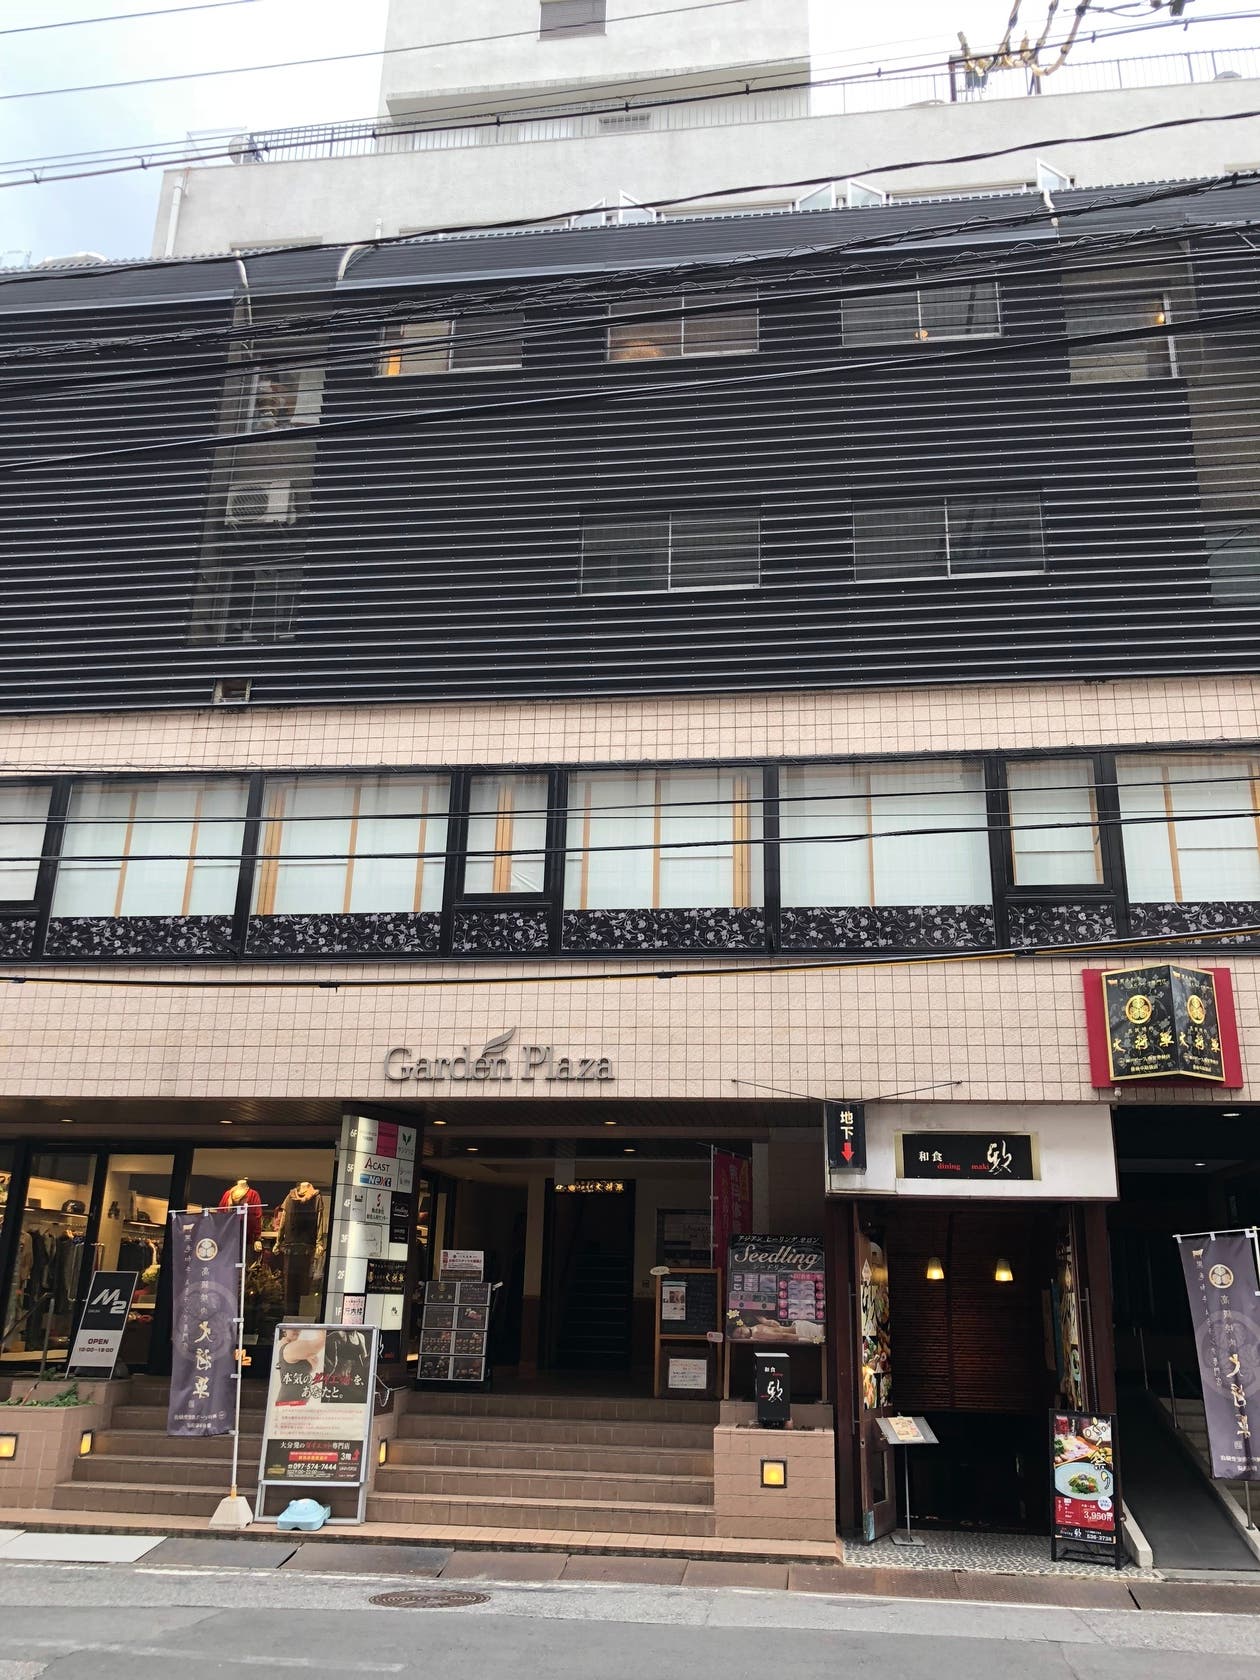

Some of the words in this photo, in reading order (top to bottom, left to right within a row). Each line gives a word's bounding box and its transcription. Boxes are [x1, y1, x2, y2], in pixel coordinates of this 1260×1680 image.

[383, 1046, 513, 1082] Garden
[521, 1045, 616, 1081] Plaza
[839, 1110, 855, 1140] 地下
[918, 1150, 943, 1163] 和食
[364, 1156, 391, 1173] ACAST
[936, 1162, 961, 1171] dining
[971, 1162, 990, 1171] maki
[734, 1244, 819, 1271] Seedling
[90, 1288, 128, 1314] M2
[301, 1386, 344, 1399] あなたと。
[340, 1452, 352, 1461] 3階
[293, 1462, 338, 1471] 097-574-7444
